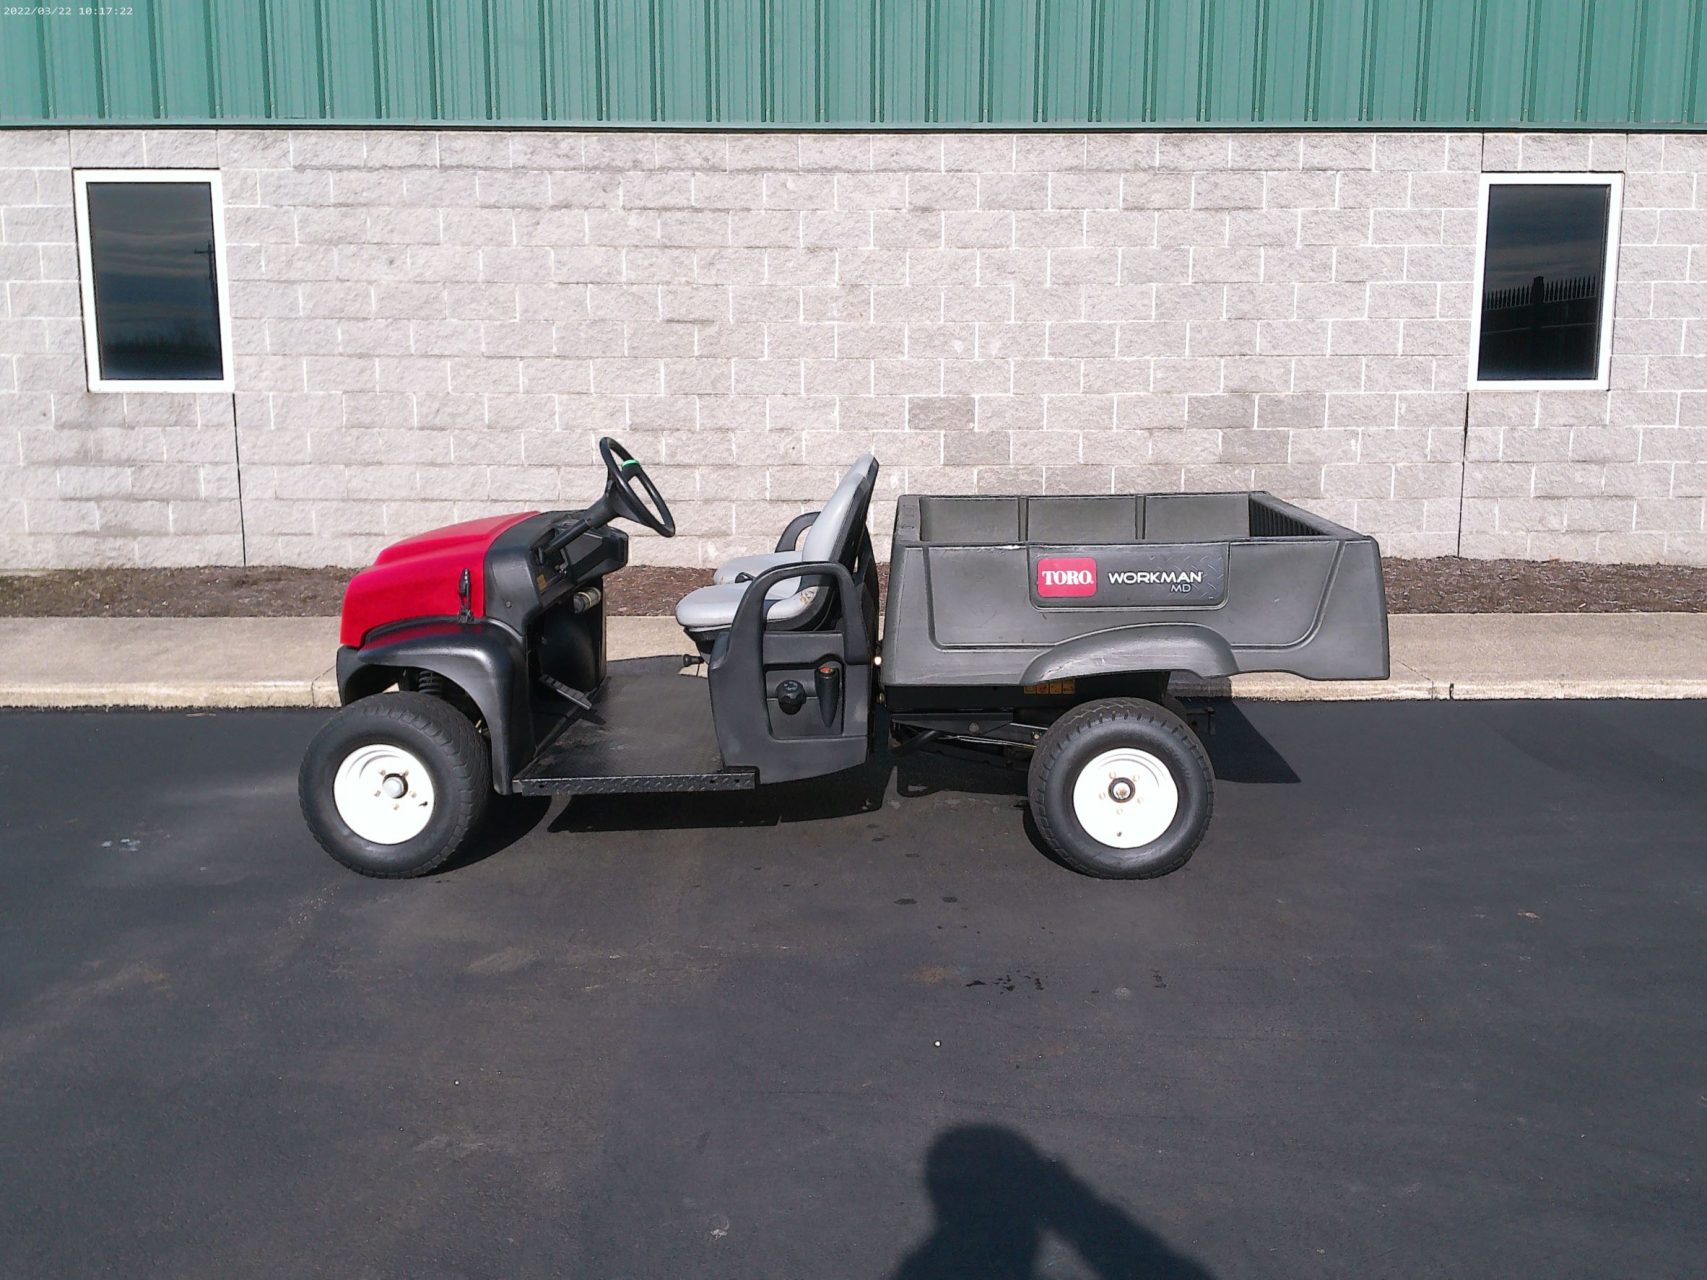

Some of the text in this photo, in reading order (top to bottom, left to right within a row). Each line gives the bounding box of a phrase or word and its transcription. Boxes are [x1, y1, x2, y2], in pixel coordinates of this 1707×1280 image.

[1041, 569, 1203, 586] TORO WORKMAN
[1170, 583, 1192, 593] MD
